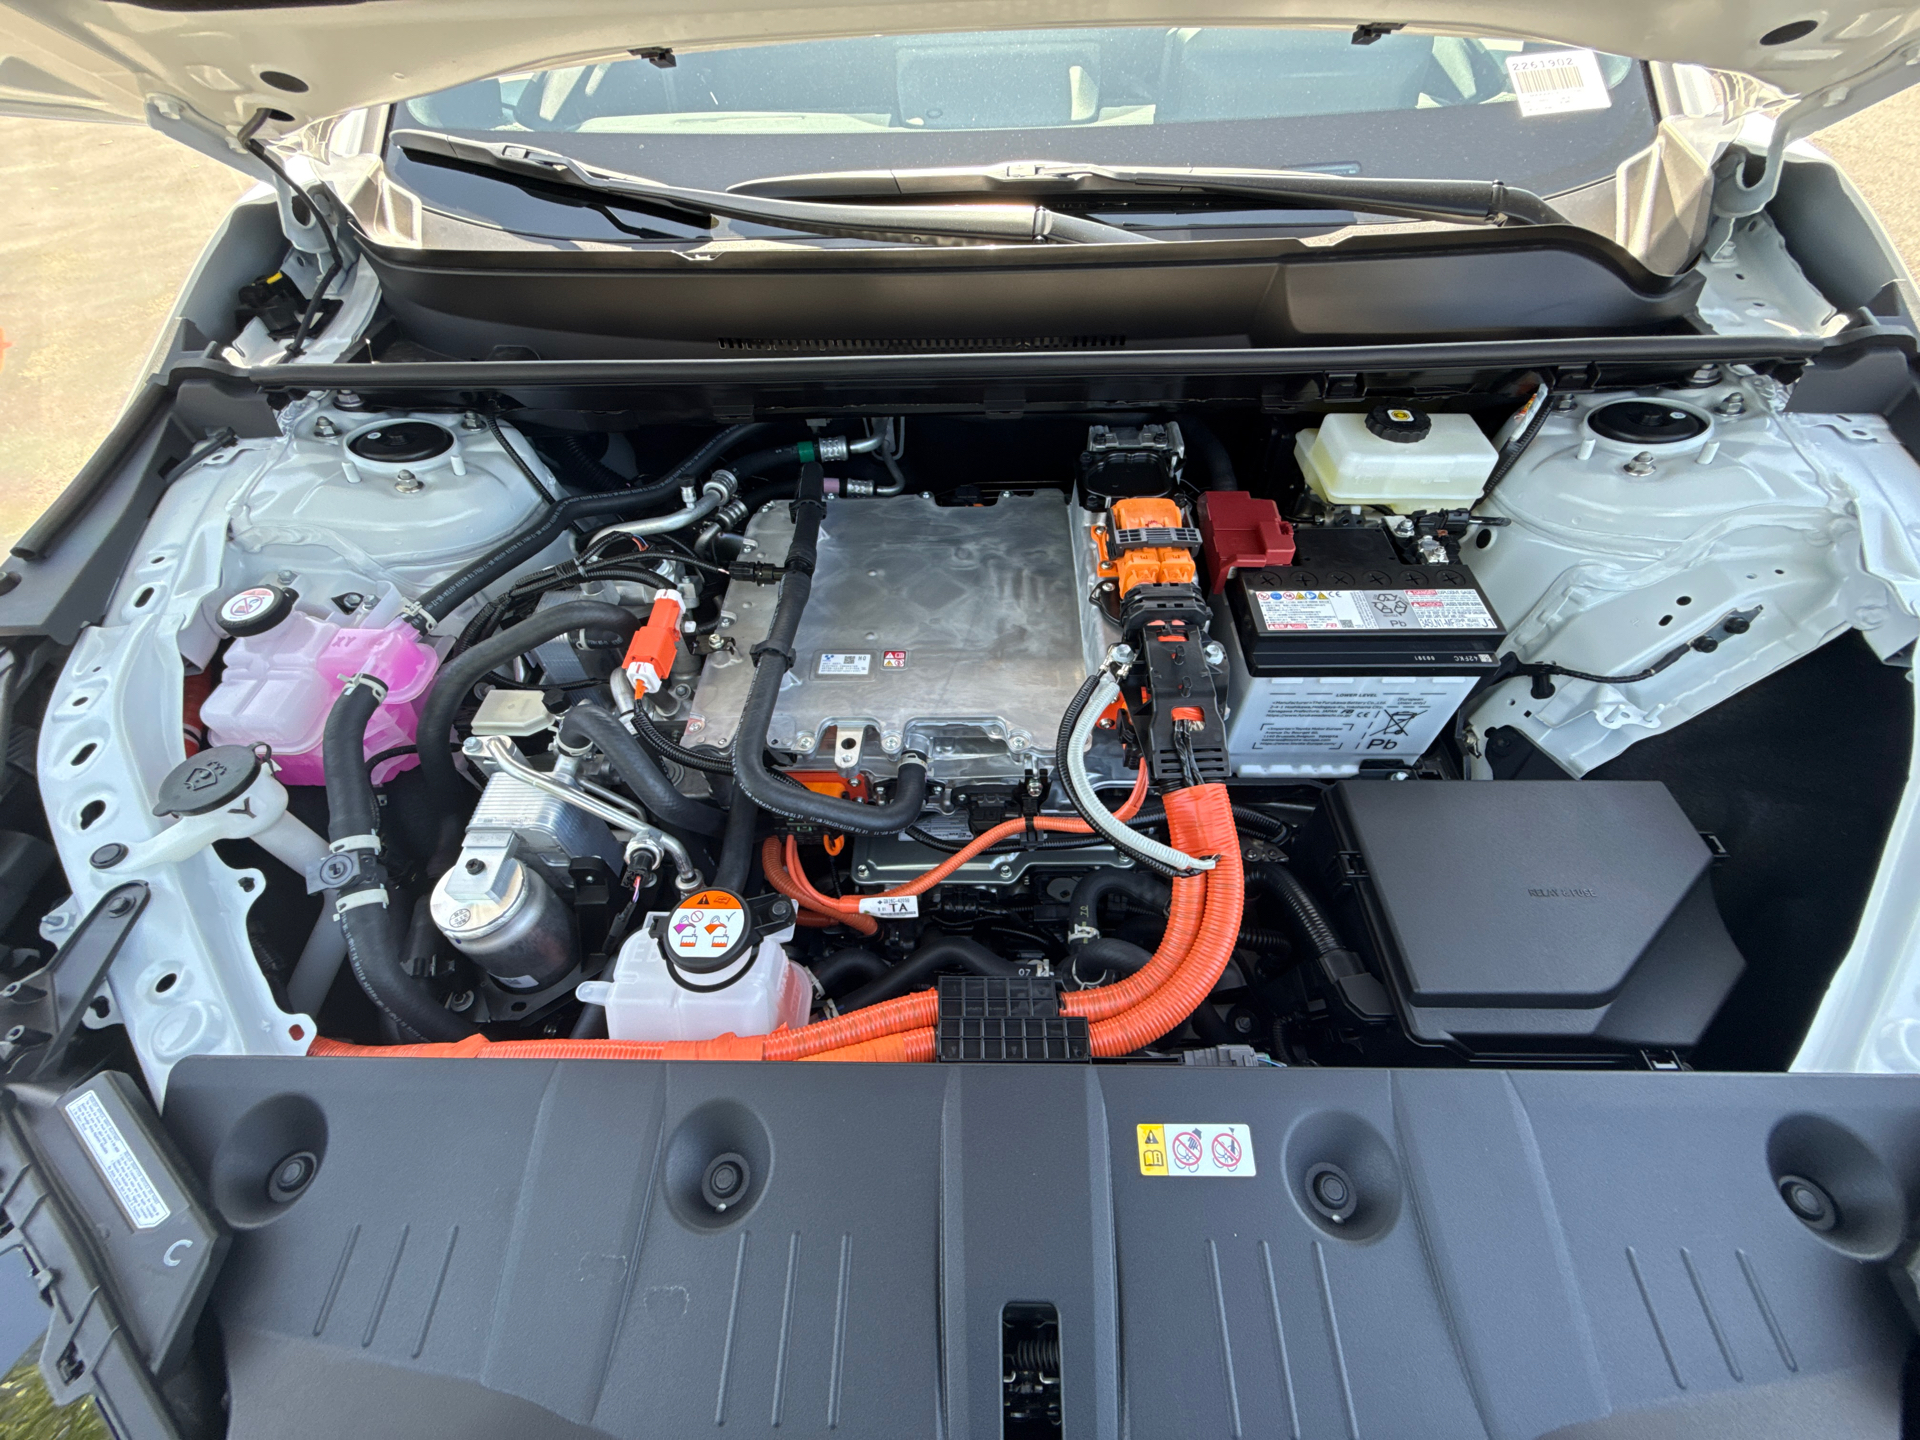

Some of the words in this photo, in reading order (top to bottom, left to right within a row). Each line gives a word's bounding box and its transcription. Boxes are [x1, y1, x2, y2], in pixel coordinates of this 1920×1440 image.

[1512, 57, 1574, 70] 2261902
[1482, 619, 1496, 627] J1
[332, 636, 356, 648] XY
[1366, 739, 1397, 750] Pb
[228, 796, 257, 819] Y
[1528, 888, 1559, 897] RELAY
[1570, 888, 1597, 897] FUSE
[889, 903, 908, 912] TA
[1018, 968, 1031, 976] 07
[163, 1239, 193, 1266] C
